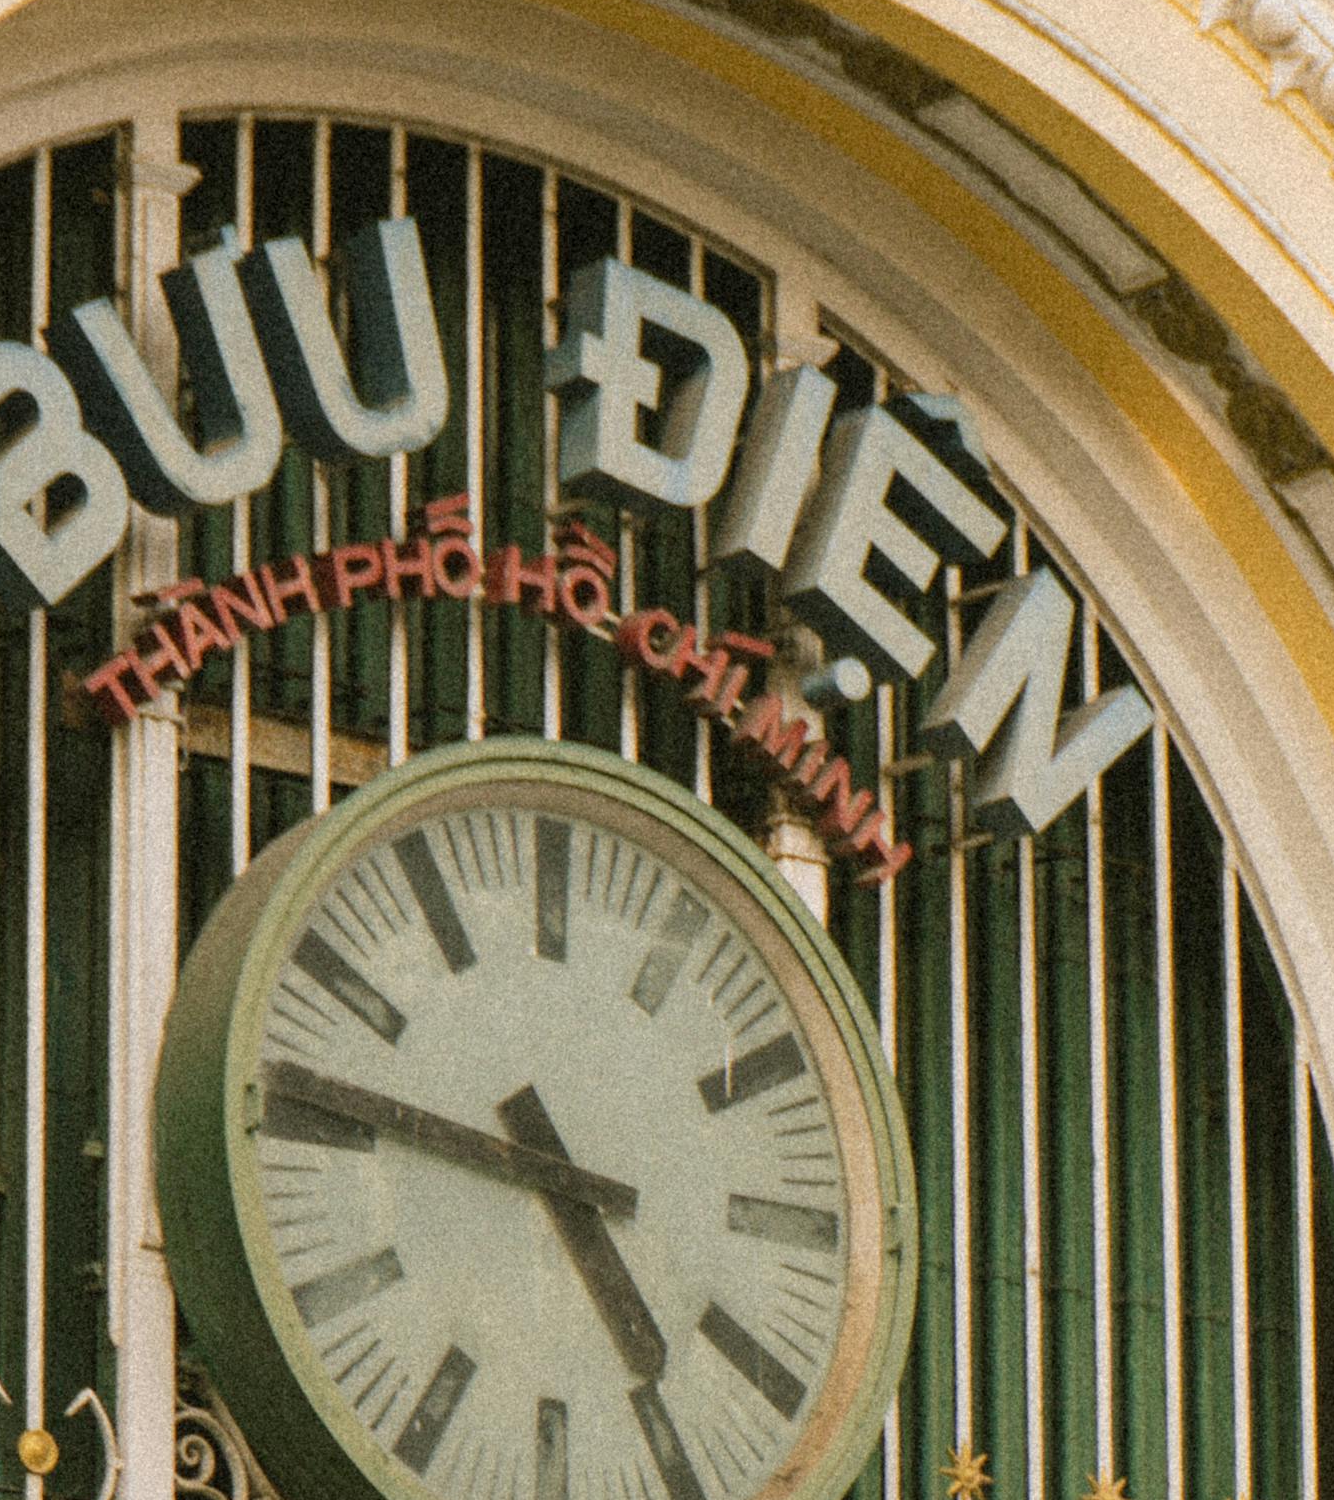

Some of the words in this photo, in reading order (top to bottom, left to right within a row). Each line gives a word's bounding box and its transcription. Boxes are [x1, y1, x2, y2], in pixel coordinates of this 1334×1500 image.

[83, 576, 323, 724] THÀNH
[327, 492, 477, 608] PHỐ
[501, 520, 621, 626] HỒ
[618, 606, 777, 716] CHÍ
[737, 696, 913, 888] MINH
[549, 257, 1155, 834] ĐIỆN
